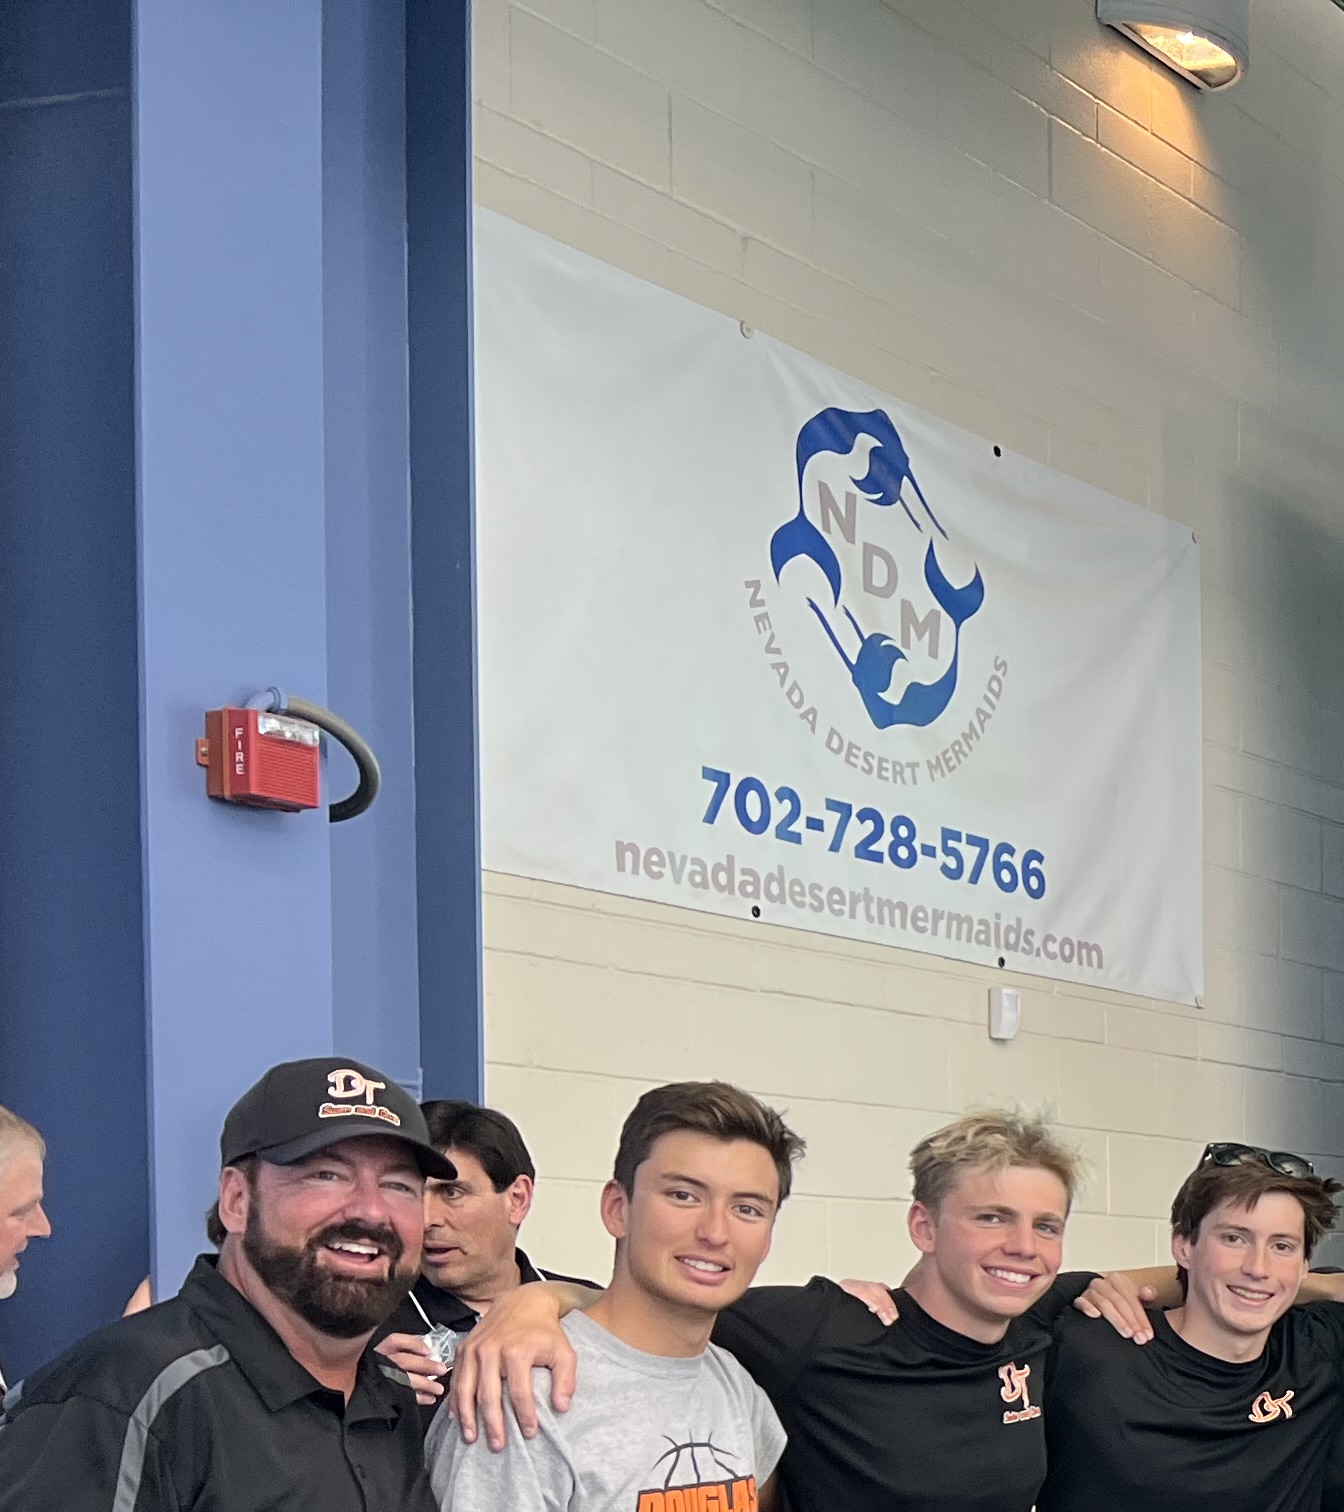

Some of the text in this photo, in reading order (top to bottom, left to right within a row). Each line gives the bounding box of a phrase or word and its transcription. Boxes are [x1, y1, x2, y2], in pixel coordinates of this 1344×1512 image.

[744, 579, 1008, 786] NEVADA DESERT MERMAIDS
[234, 727, 245, 776] FIRE
[701, 765, 1046, 900] 702-728-5766
[614, 840, 1104, 970] nevadadesertmermaids.com
